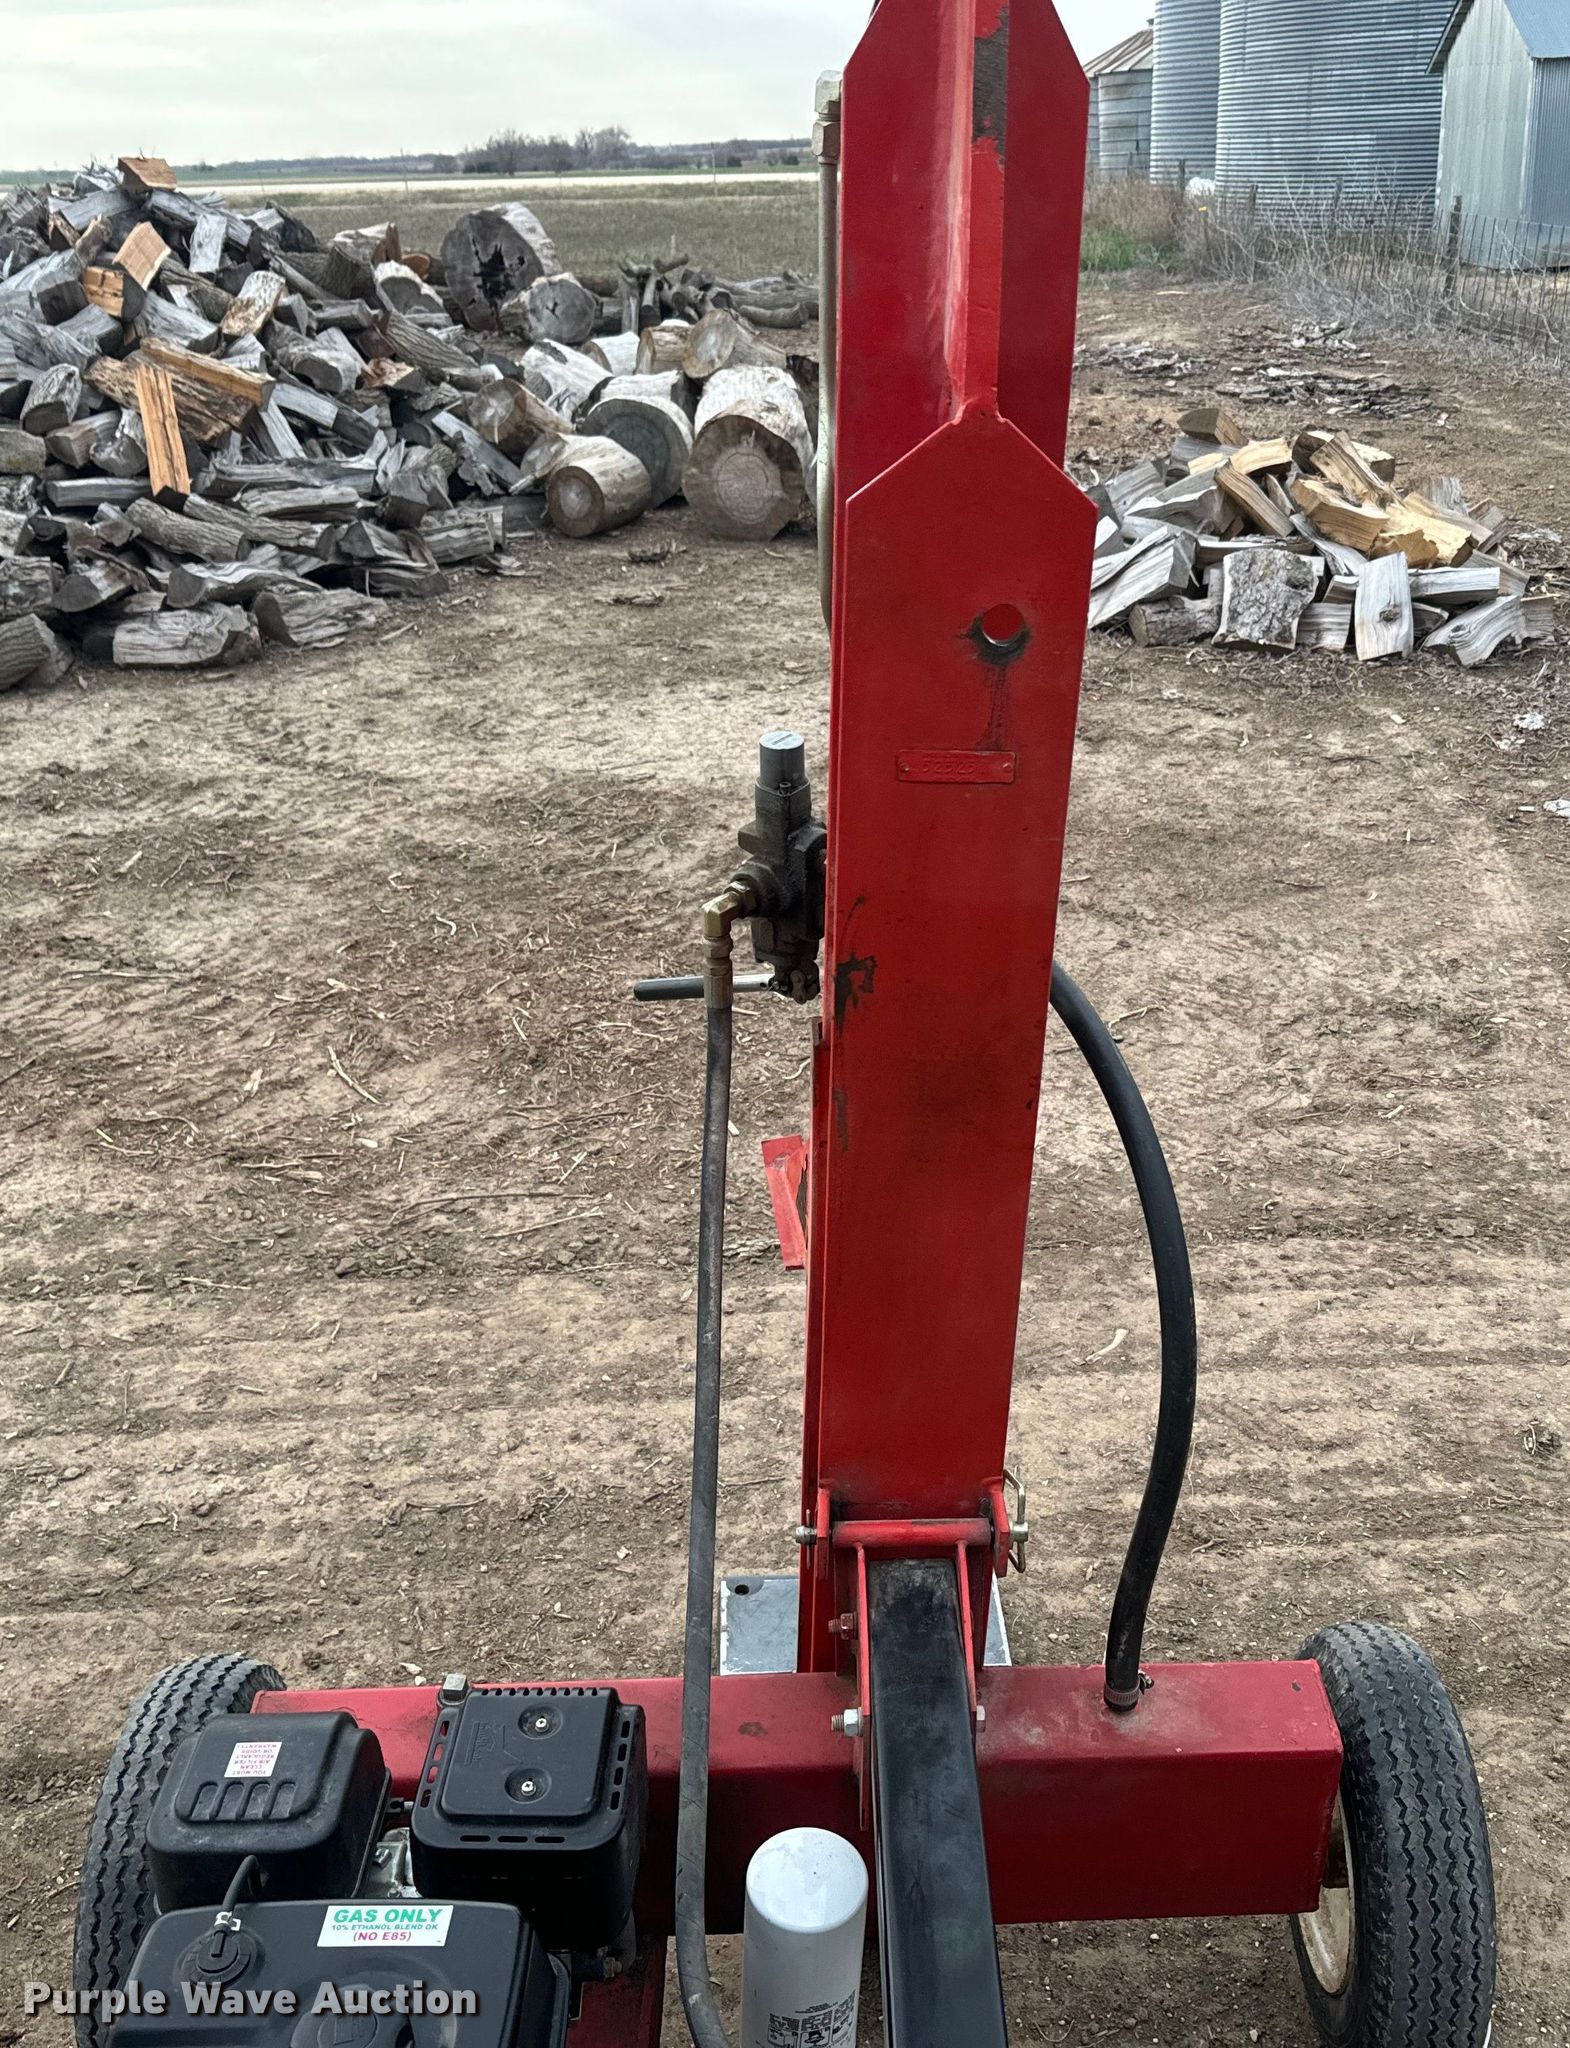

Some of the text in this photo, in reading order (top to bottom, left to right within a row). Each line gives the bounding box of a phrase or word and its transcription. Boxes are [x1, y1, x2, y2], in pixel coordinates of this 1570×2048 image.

[333, 1909, 443, 1923] GAS ONLY
[353, 1931, 412, 1942] (NO E85)
